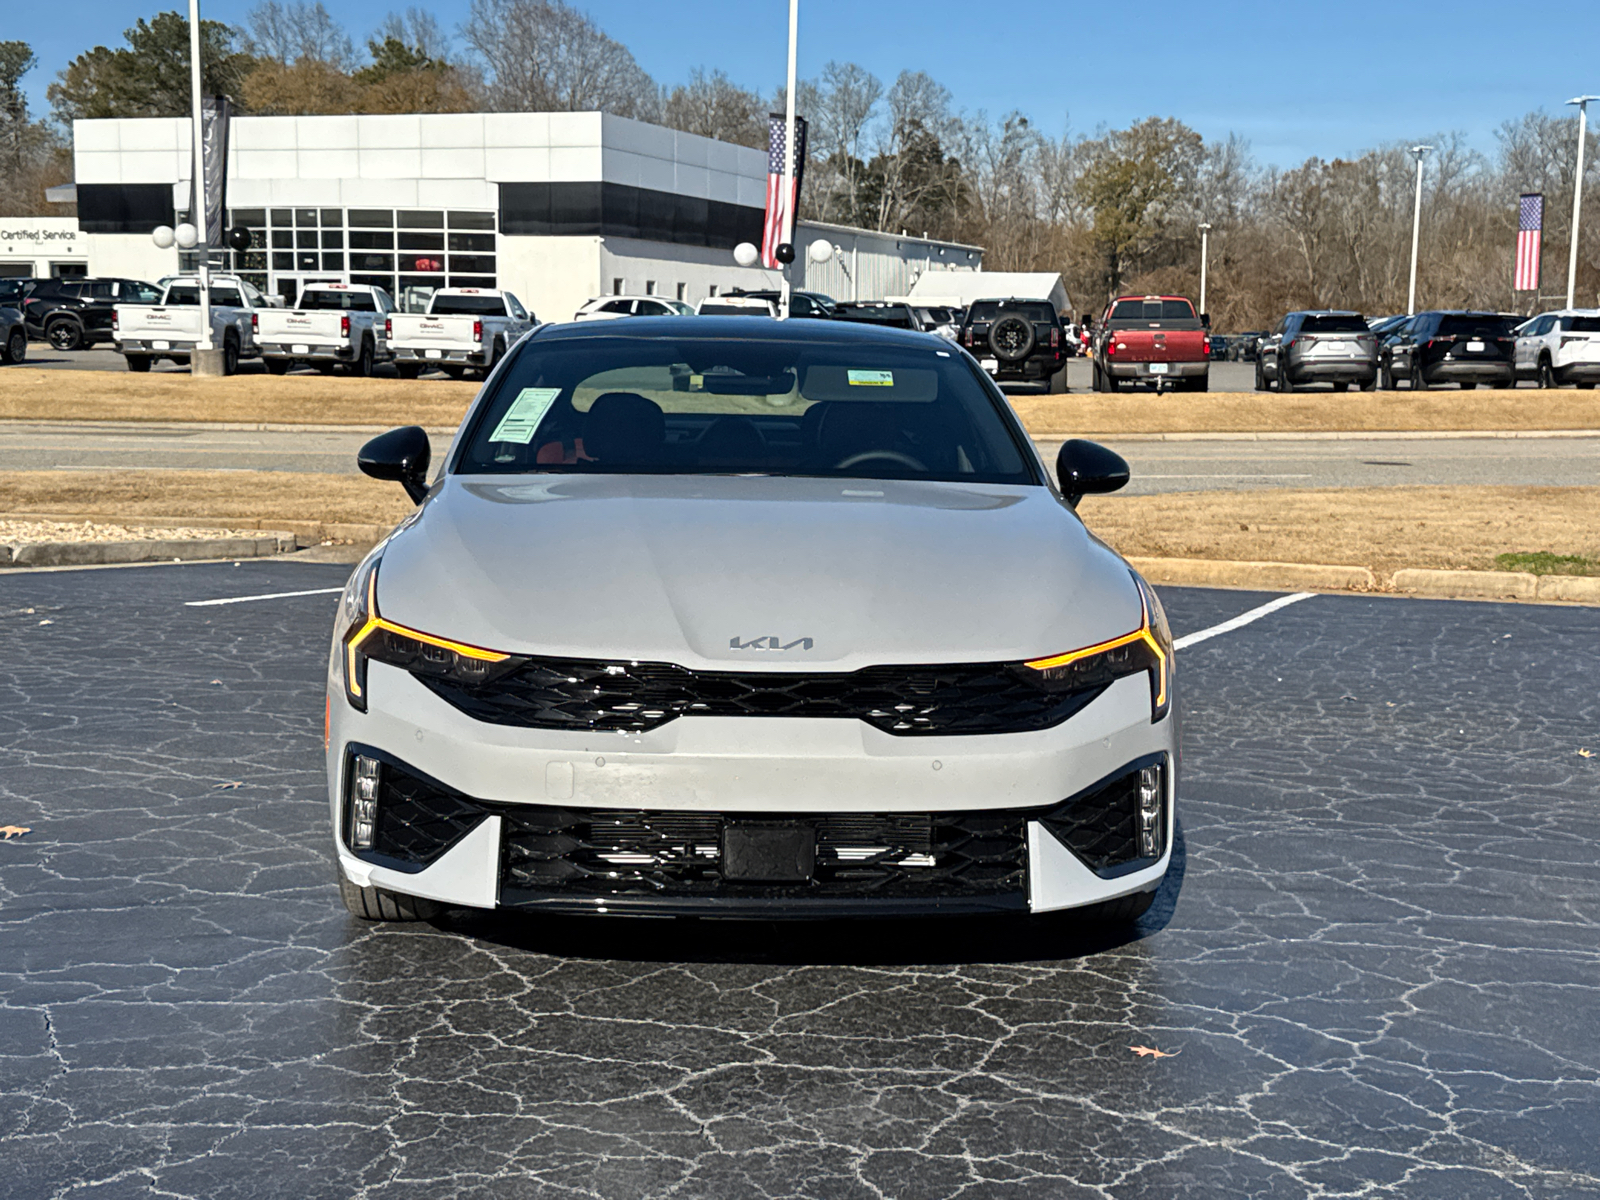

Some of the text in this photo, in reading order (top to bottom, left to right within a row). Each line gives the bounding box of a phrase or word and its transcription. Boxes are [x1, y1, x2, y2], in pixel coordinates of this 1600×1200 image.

[1, 229, 76, 240] Certified Service
[730, 636, 813, 651] KIA
